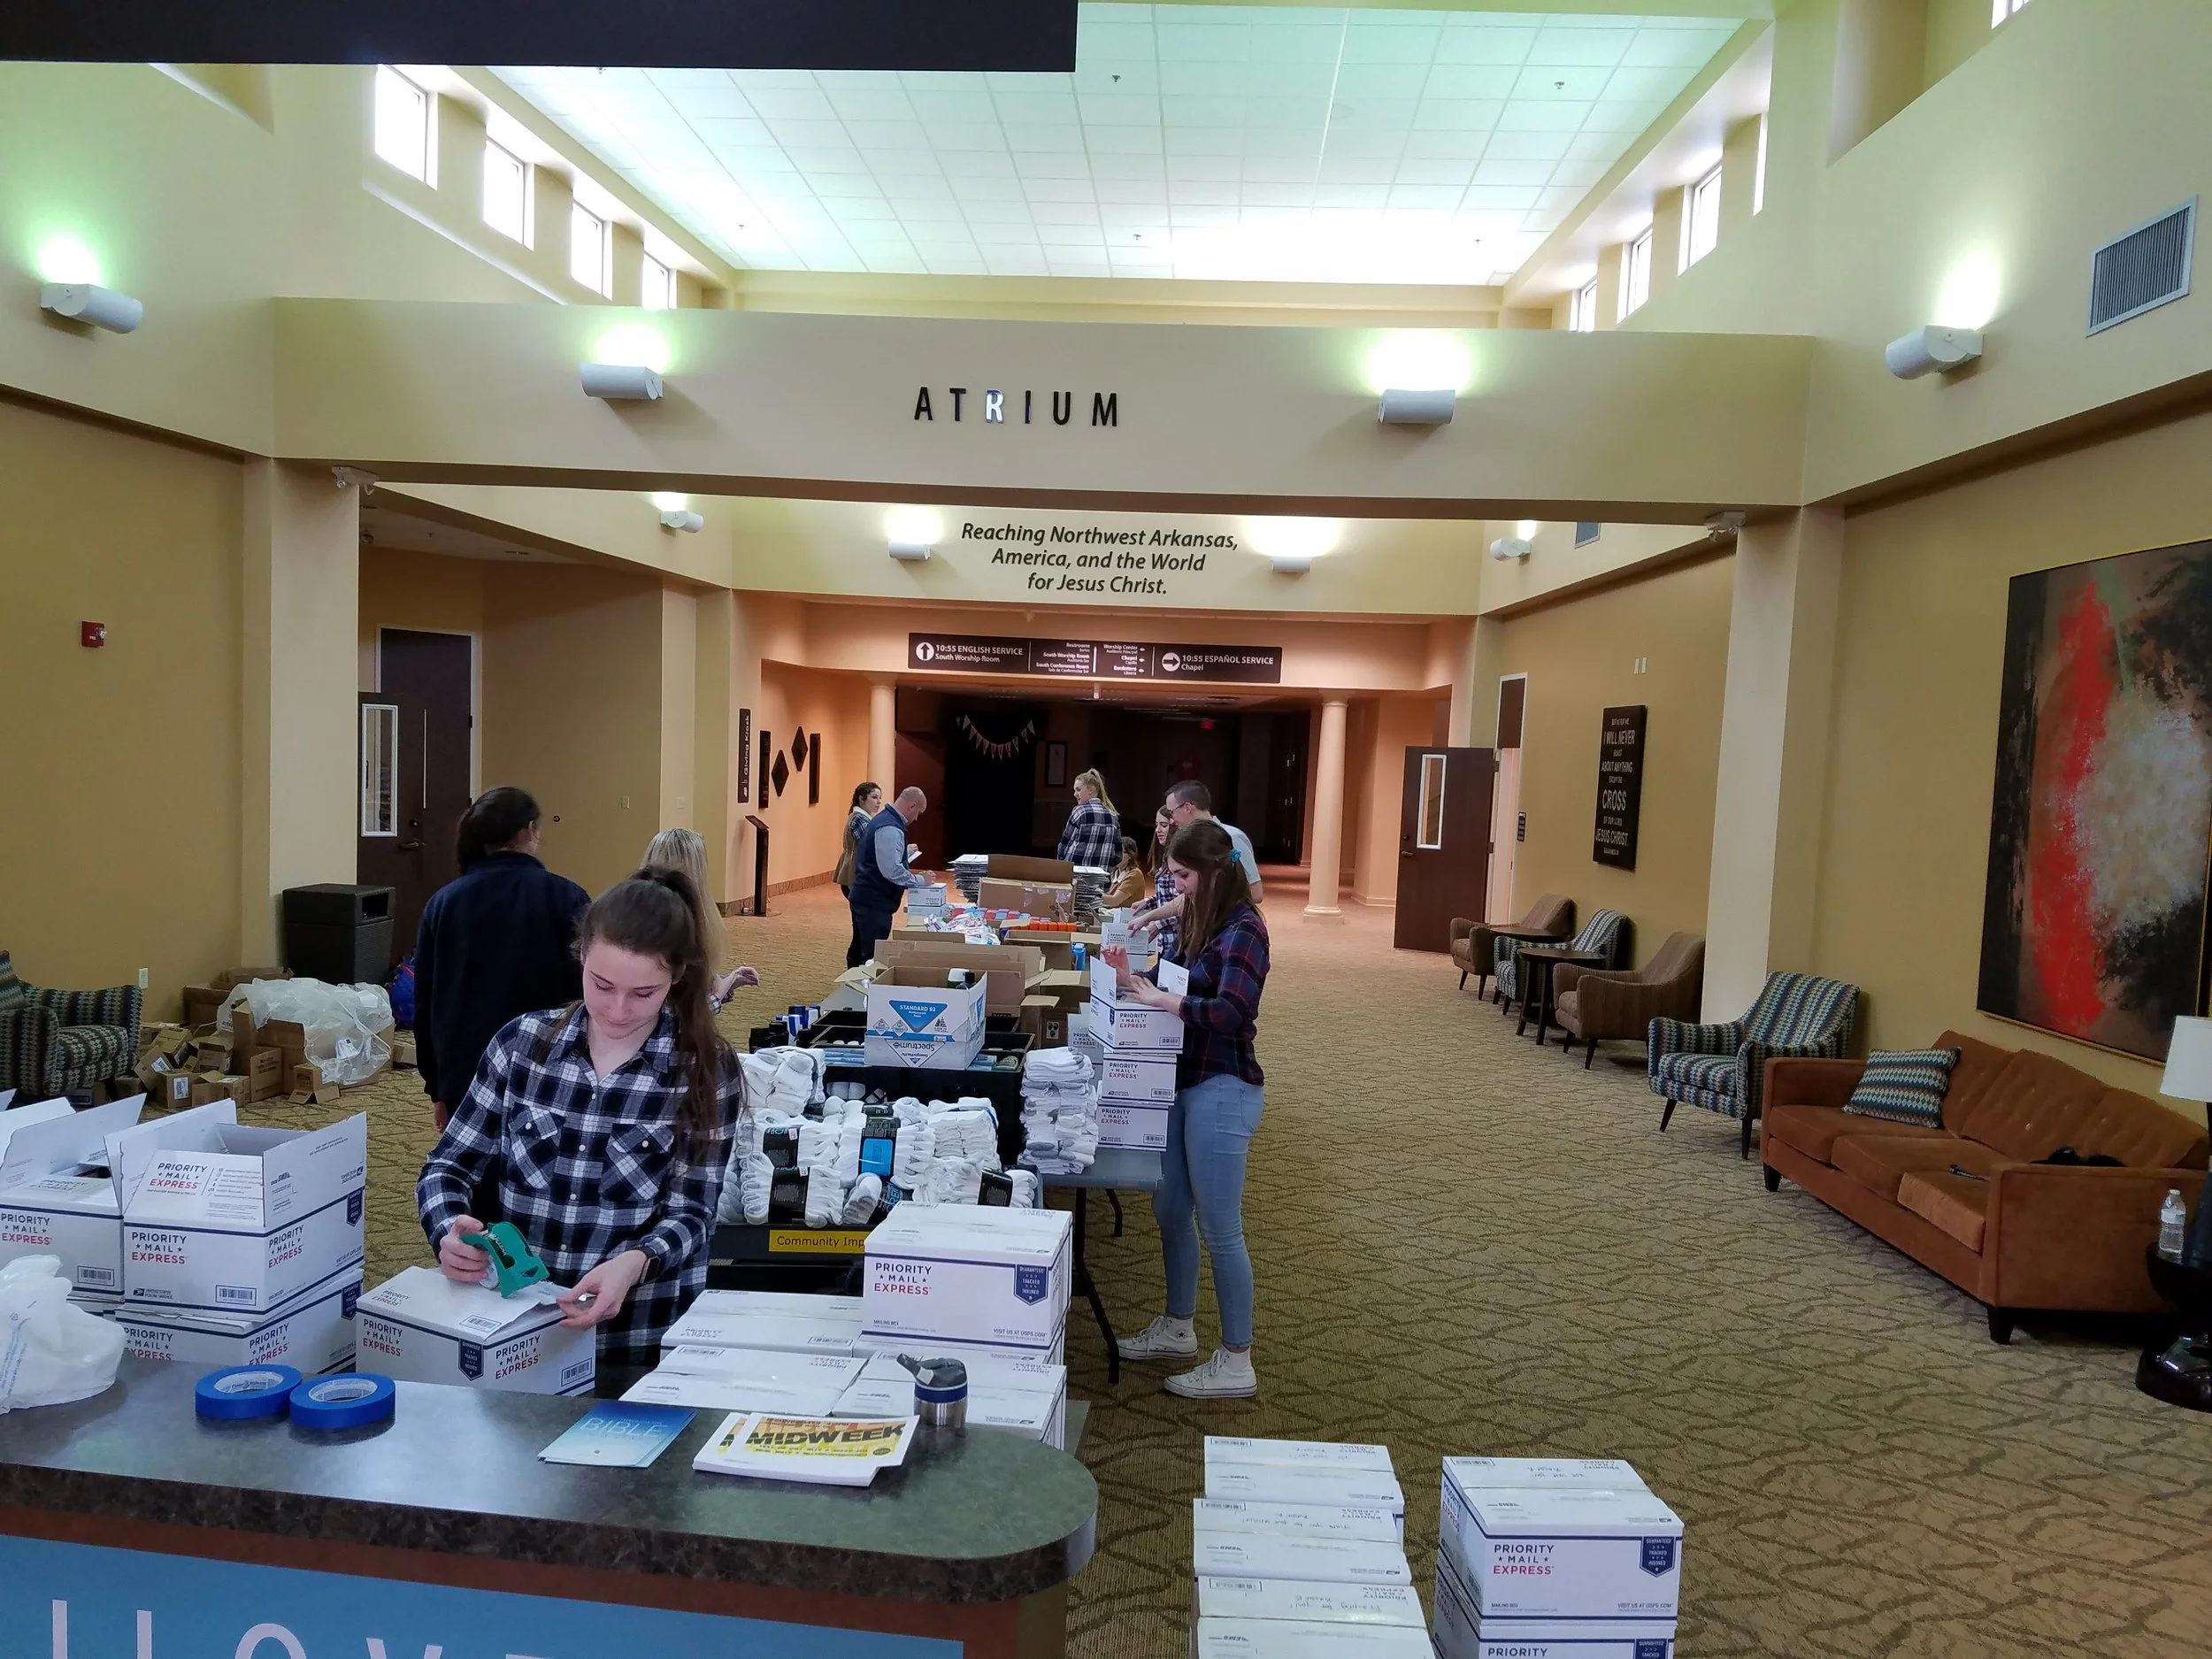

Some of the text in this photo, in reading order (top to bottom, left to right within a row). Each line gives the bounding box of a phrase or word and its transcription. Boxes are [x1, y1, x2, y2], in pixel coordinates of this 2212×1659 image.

[914, 387, 1118, 426] ATRIUM
[961, 522, 1239, 550] Reaching Northwest Arkansas,
[991, 547, 1206, 572] America, and the World
[1027, 572, 1167, 595] for Jesus Christ.
[957, 645, 989, 654] ENGLISH
[991, 647, 1023, 656] SERVICE
[955, 654, 980, 663] Worship
[1204, 654, 1240, 664] ESPAÑOL
[1606, 731, 1617, 744] WILL
[1618, 729, 1636, 745] NEVER
[1601, 760, 1633, 772] ABOUT ANYTHING
[1602, 789, 1627, 811] CROSS
[1595, 828, 1610, 844] JESUS
[900, 1042, 935, 1052] Spectrum
[157, 1163, 208, 1173] PRIORITY
[150, 1179, 199, 1190] EXPRESS
[0, 1213, 50, 1226] PRIORITY
[12, 1225, 38, 1234] MAIL
[2, 1233, 51, 1246] EXPRESS
[132, 1232, 188, 1245] PRIORITY
[268, 1225, 304, 1249] PRIORITY
[777, 1236, 864, 1248] Community Imp
[144, 1243, 173, 1254] MAIL
[276, 1239, 295, 1255] MAIL
[132, 1251, 187, 1265] EXPRESS
[268, 1245, 303, 1269] EXPRESS
[876, 1262, 932, 1275] PRIORITY
[888, 1275, 918, 1284] MAIL
[874, 1283, 931, 1295] EXPRESS
[124, 1327, 173, 1343] PRIORITY
[364, 1318, 403, 1339] PRIORITY
[249, 1322, 289, 1349] PRIORITY
[373, 1332, 394, 1345] MAIL
[134, 1340, 160, 1350] MAIL
[258, 1337, 280, 1356] MAIL
[363, 1337, 403, 1357] EXPRESS
[495, 1334, 541, 1360] PRIORITY
[249, 1342, 289, 1366] EXPRESS
[506, 1351, 529, 1364] MAIL
[495, 1356, 541, 1379] EXPRESS
[580, 1417, 668, 1438] BIBLE
[745, 1422, 906, 1446] MIDWEEK
[1494, 1544, 1555, 1554] PRIORITY
[1493, 1565, 1554, 1576] EXPRESS
[1488, 1647, 1548, 1657] PRIORITY
